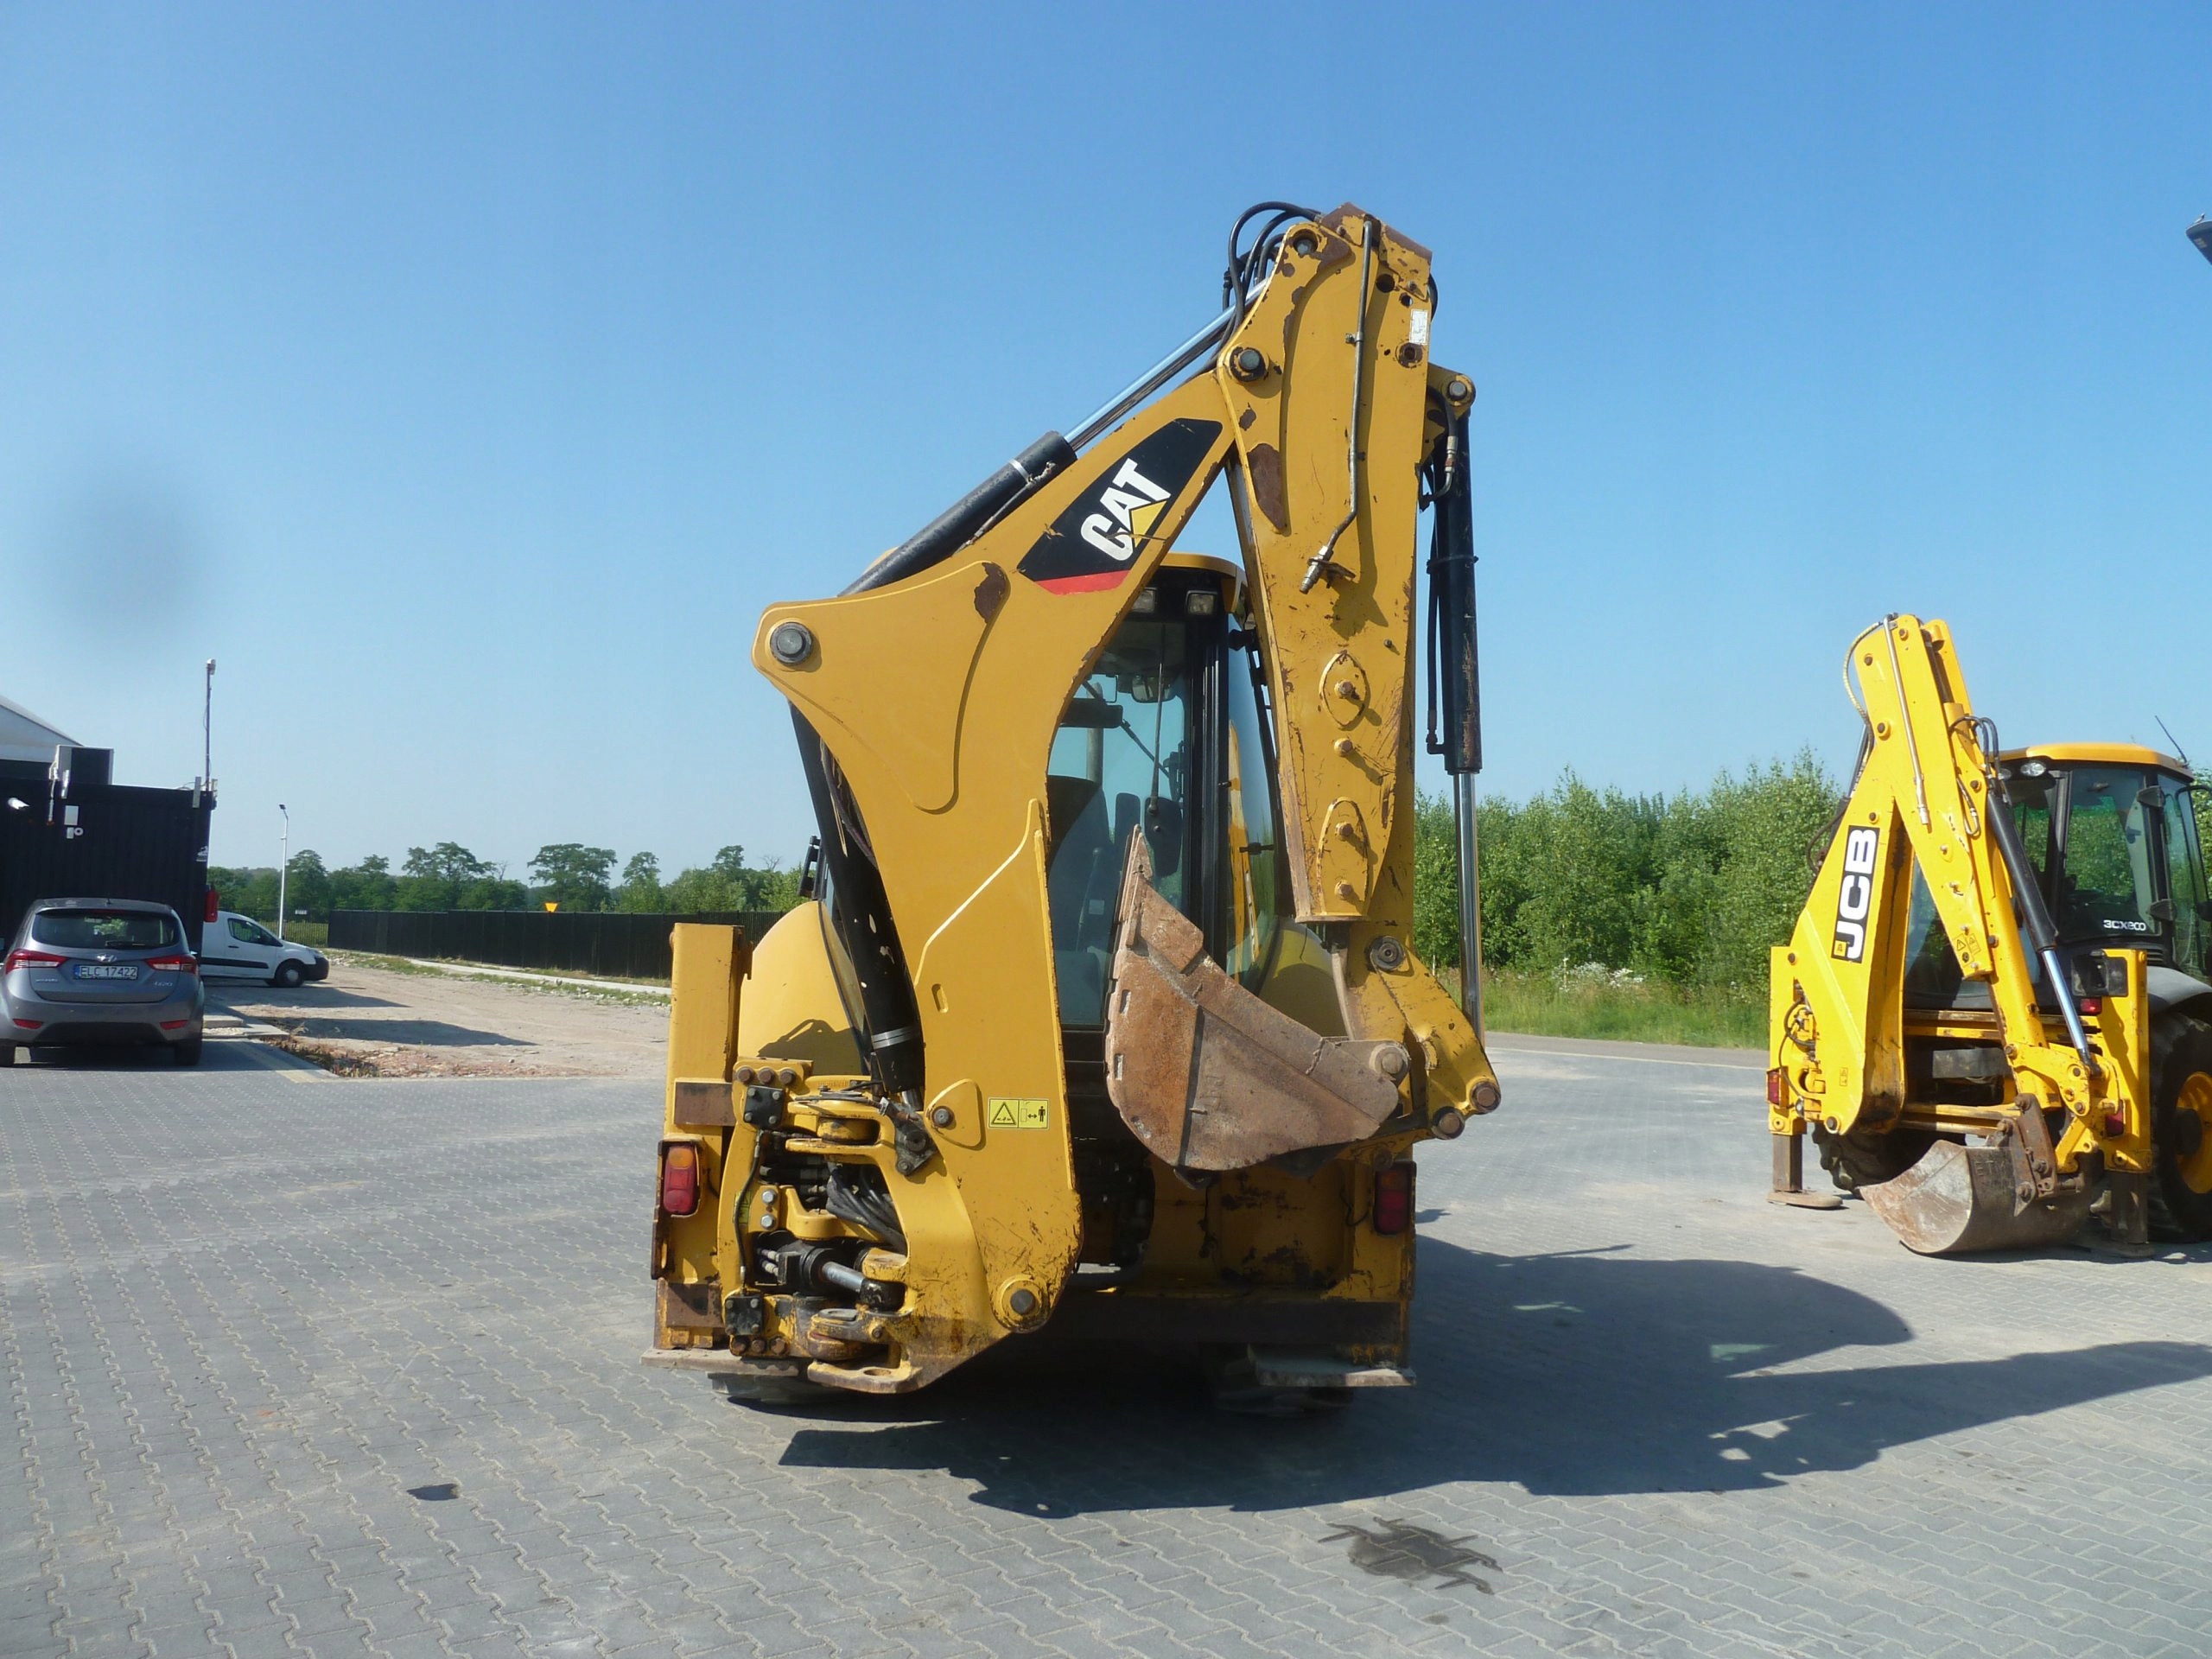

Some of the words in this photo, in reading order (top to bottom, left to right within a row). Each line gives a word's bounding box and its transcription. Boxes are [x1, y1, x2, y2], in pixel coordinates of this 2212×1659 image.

[1080, 457, 1172, 561] CAT
[1836, 830, 1877, 959] JCB
[80, 966, 101, 976] ELC
[105, 967, 137, 977] 17422
